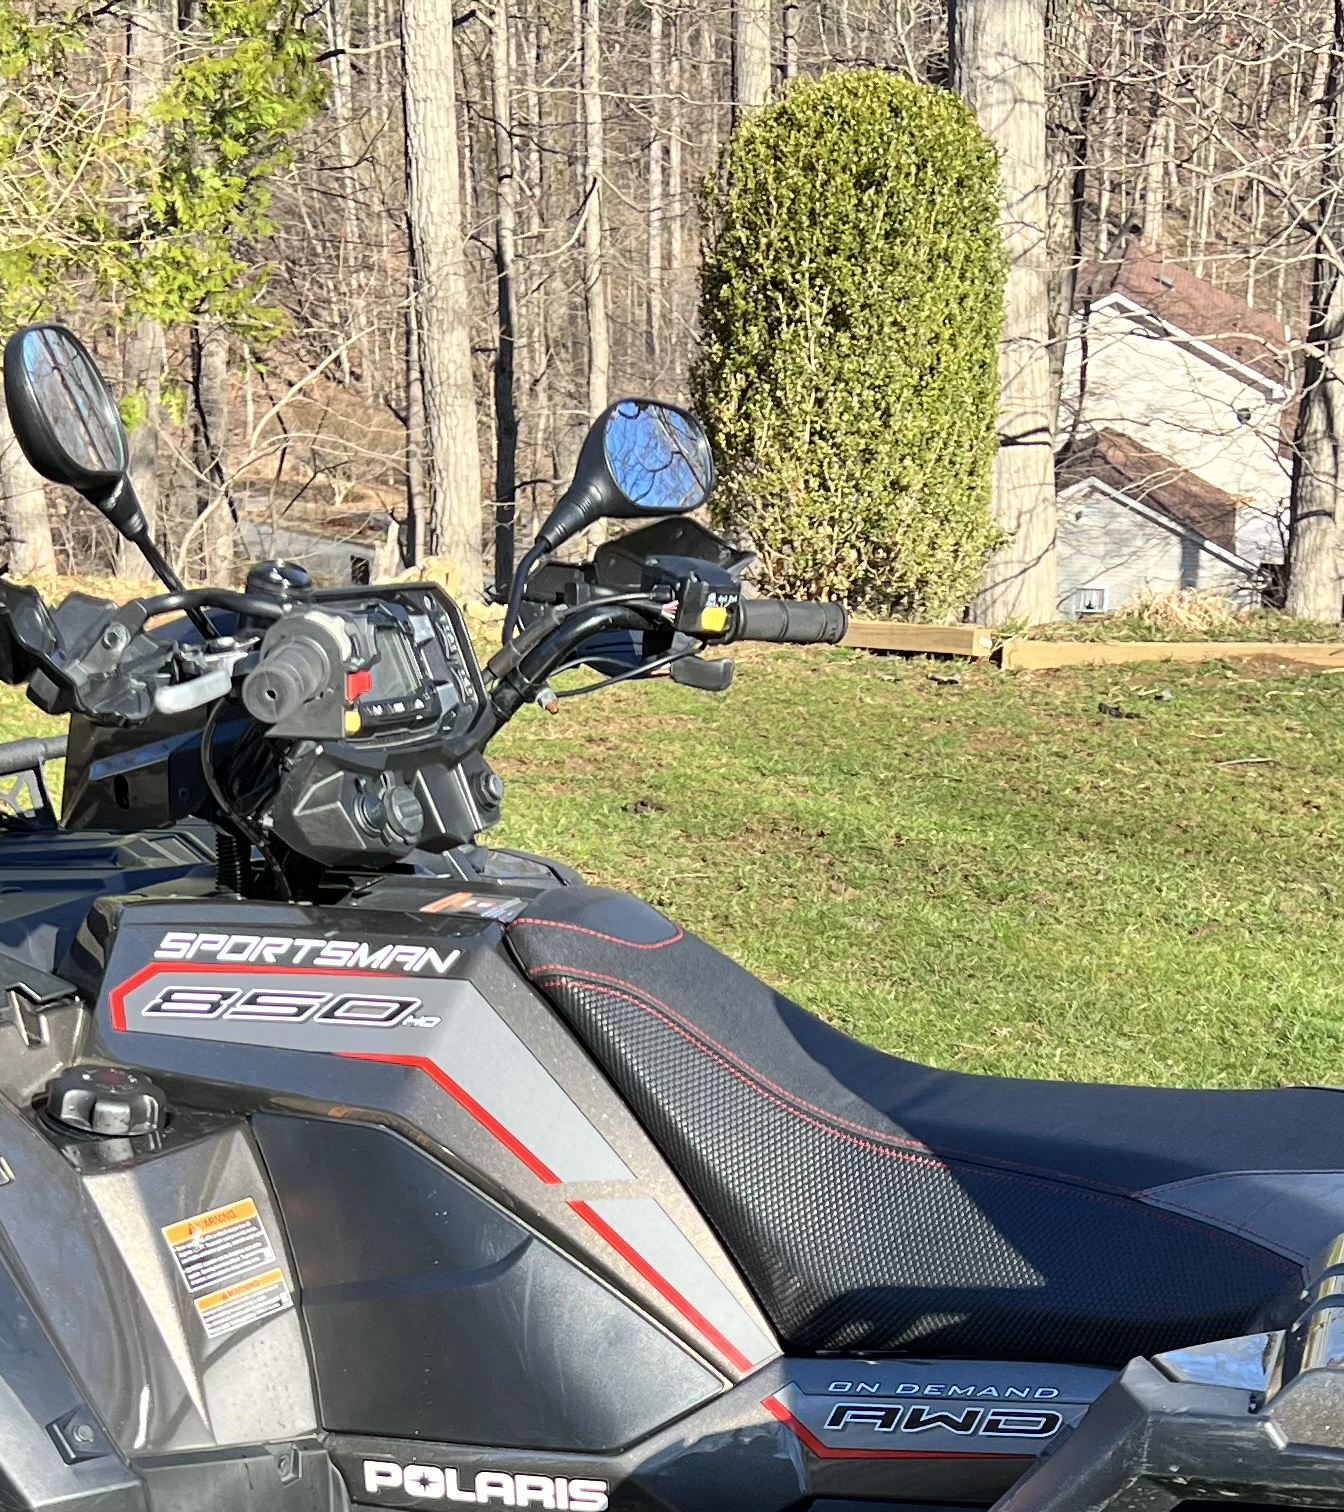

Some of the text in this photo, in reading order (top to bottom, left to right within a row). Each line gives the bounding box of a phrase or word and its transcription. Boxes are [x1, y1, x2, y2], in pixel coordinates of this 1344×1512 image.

[154, 931, 461, 974] SPORTSMAN
[141, 985, 423, 1027] 850
[197, 1209, 237, 1230] WARNING
[828, 1380, 1061, 1399] ON DEMAND
[823, 1402, 1063, 1439] AWD
[362, 1458, 609, 1512] POLARIS
